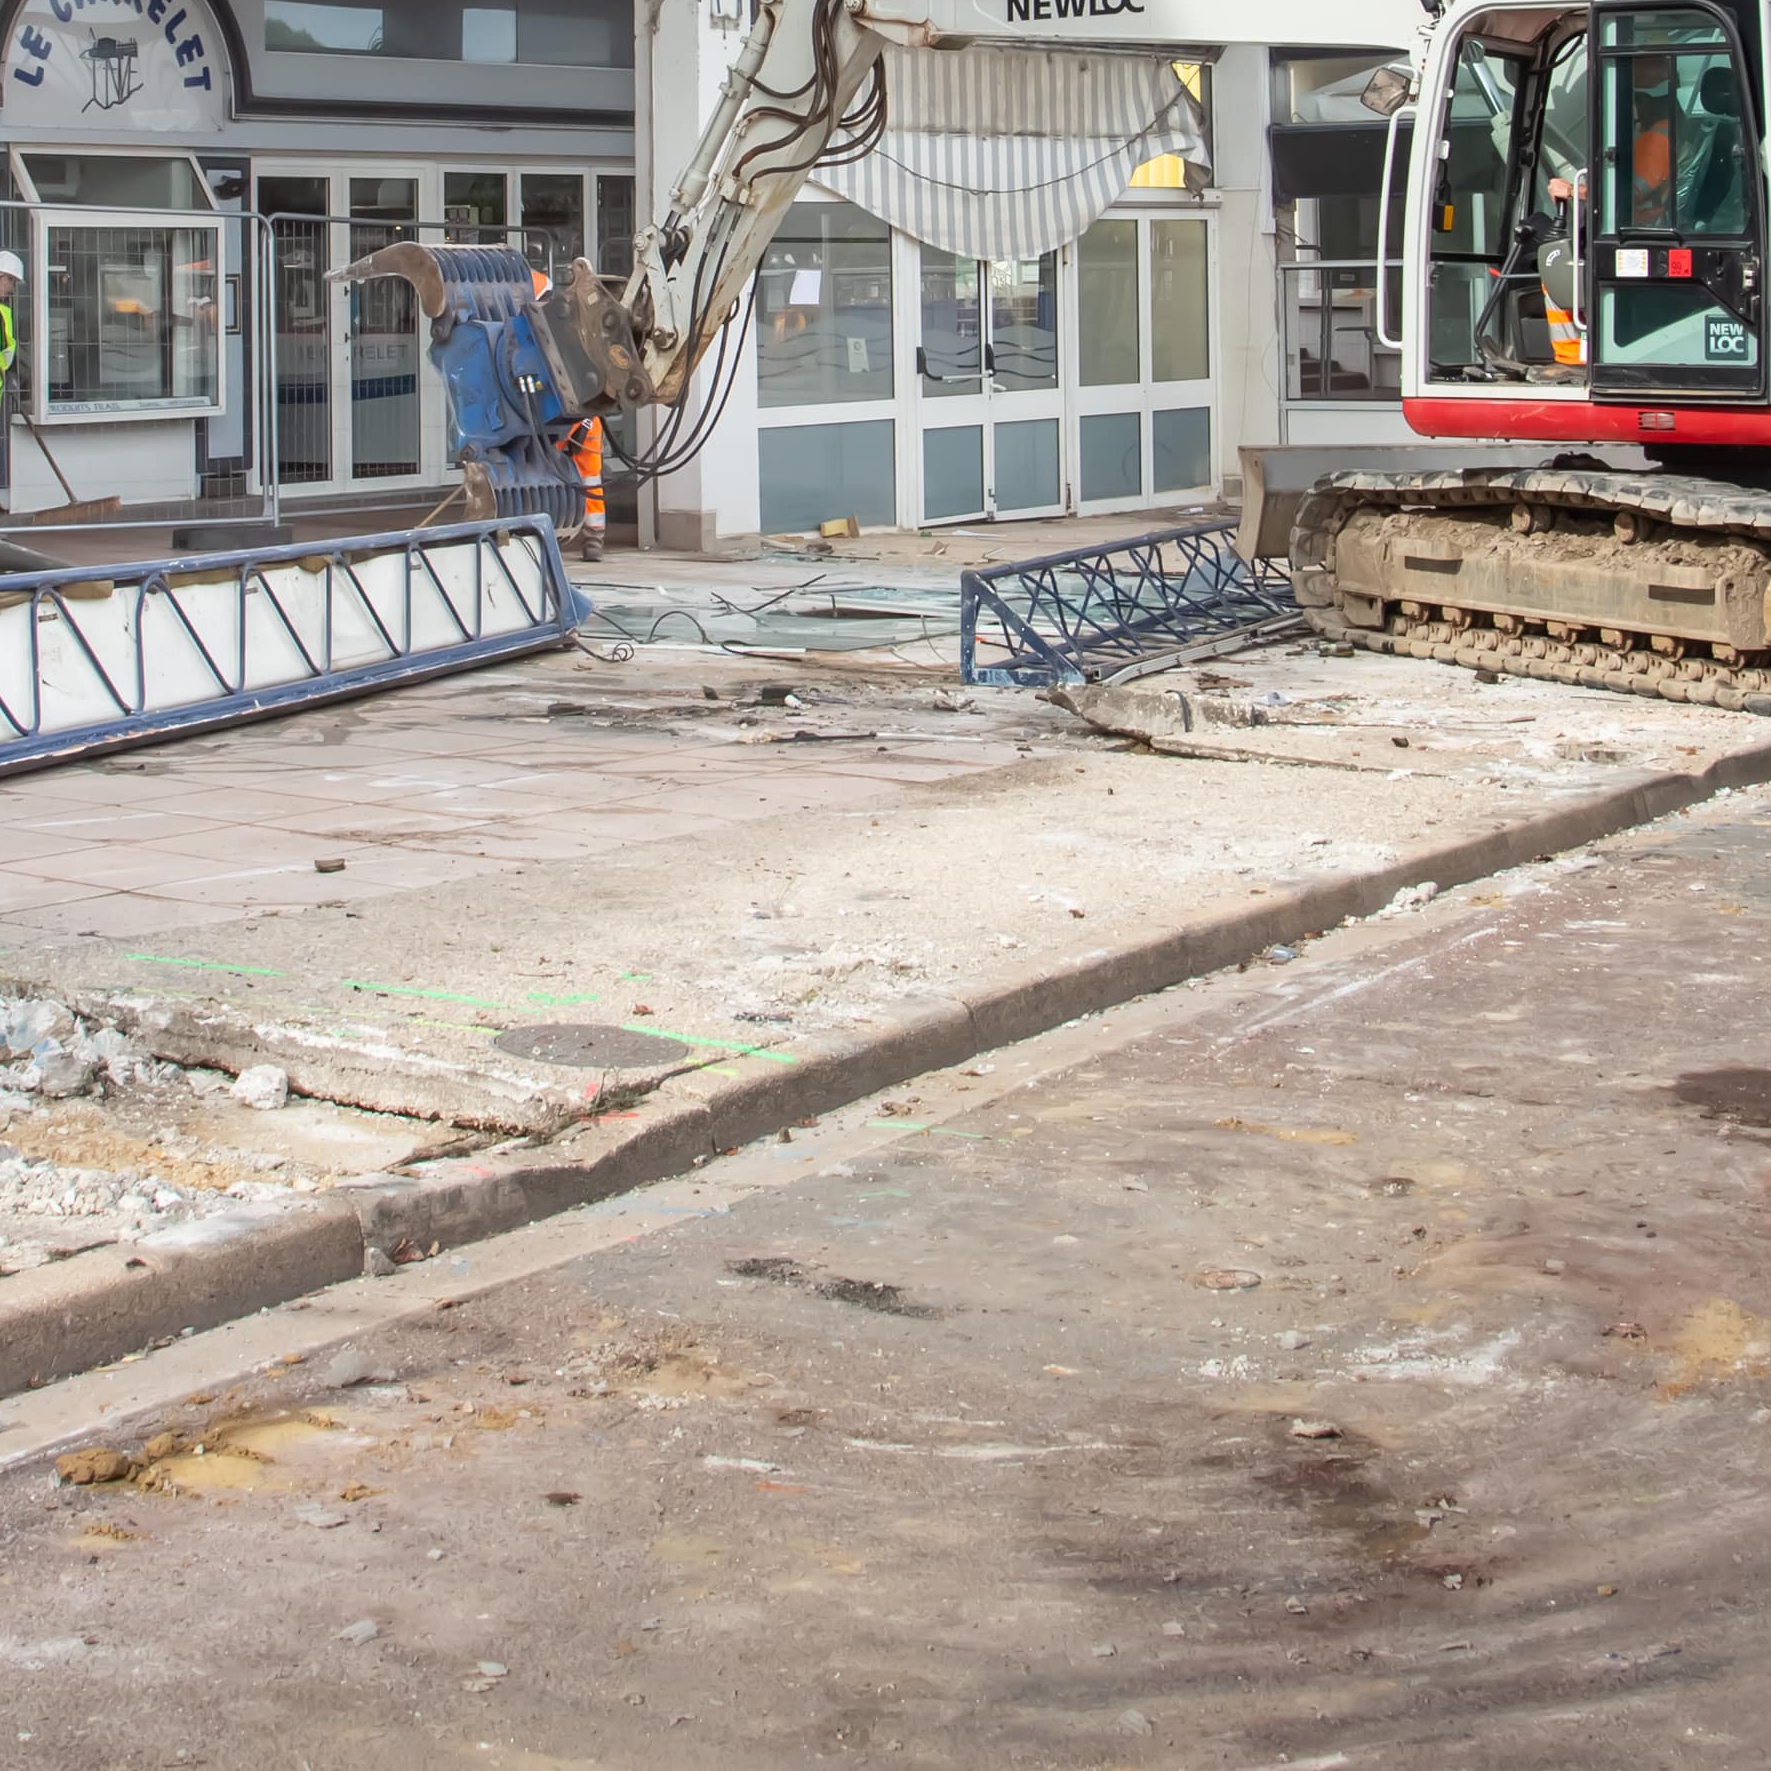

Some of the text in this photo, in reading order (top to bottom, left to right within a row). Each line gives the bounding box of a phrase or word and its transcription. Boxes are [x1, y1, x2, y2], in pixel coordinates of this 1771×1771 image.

[13, 24, 53, 87] LE
[1709, 323, 1744, 336] NEW
[1709, 336, 1745, 354] LOC
